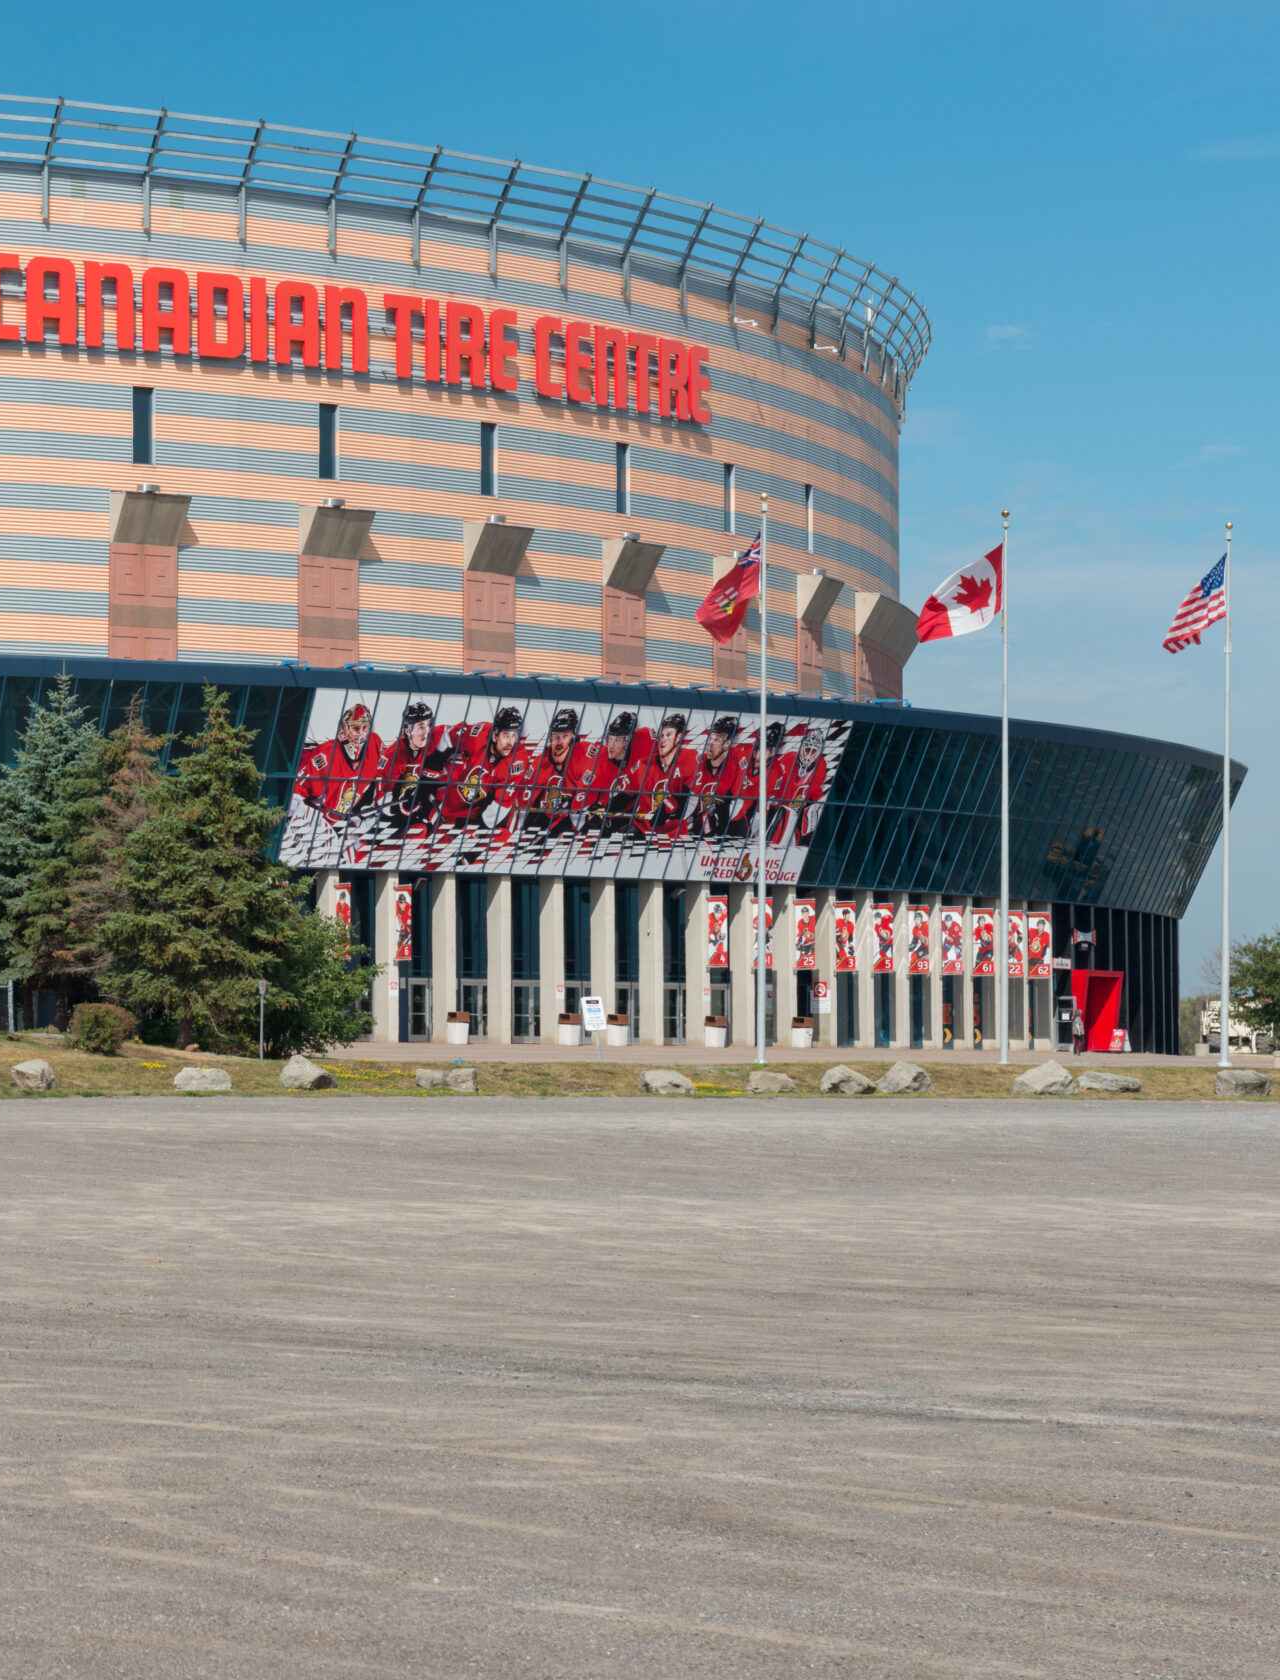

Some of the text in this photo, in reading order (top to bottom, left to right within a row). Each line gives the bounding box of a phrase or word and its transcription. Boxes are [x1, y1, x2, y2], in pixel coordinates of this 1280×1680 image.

[383, 293, 519, 392] TIRE
[534, 316, 712, 424] CENTRE
[700, 855, 739, 868] UNITED
[713, 868, 733, 879] RED
[404, 946, 410, 956] 6
[720, 955, 726, 963] 4
[803, 956, 815, 966] 25
[848, 958, 854, 967] 3
[885, 959, 891, 969] 5
[917, 959, 929, 970] 93
[954, 962, 961, 971] 9
[982, 963, 993, 972] 61
[1009, 964, 1021, 974] 22
[1037, 966, 1049, 975] 62
